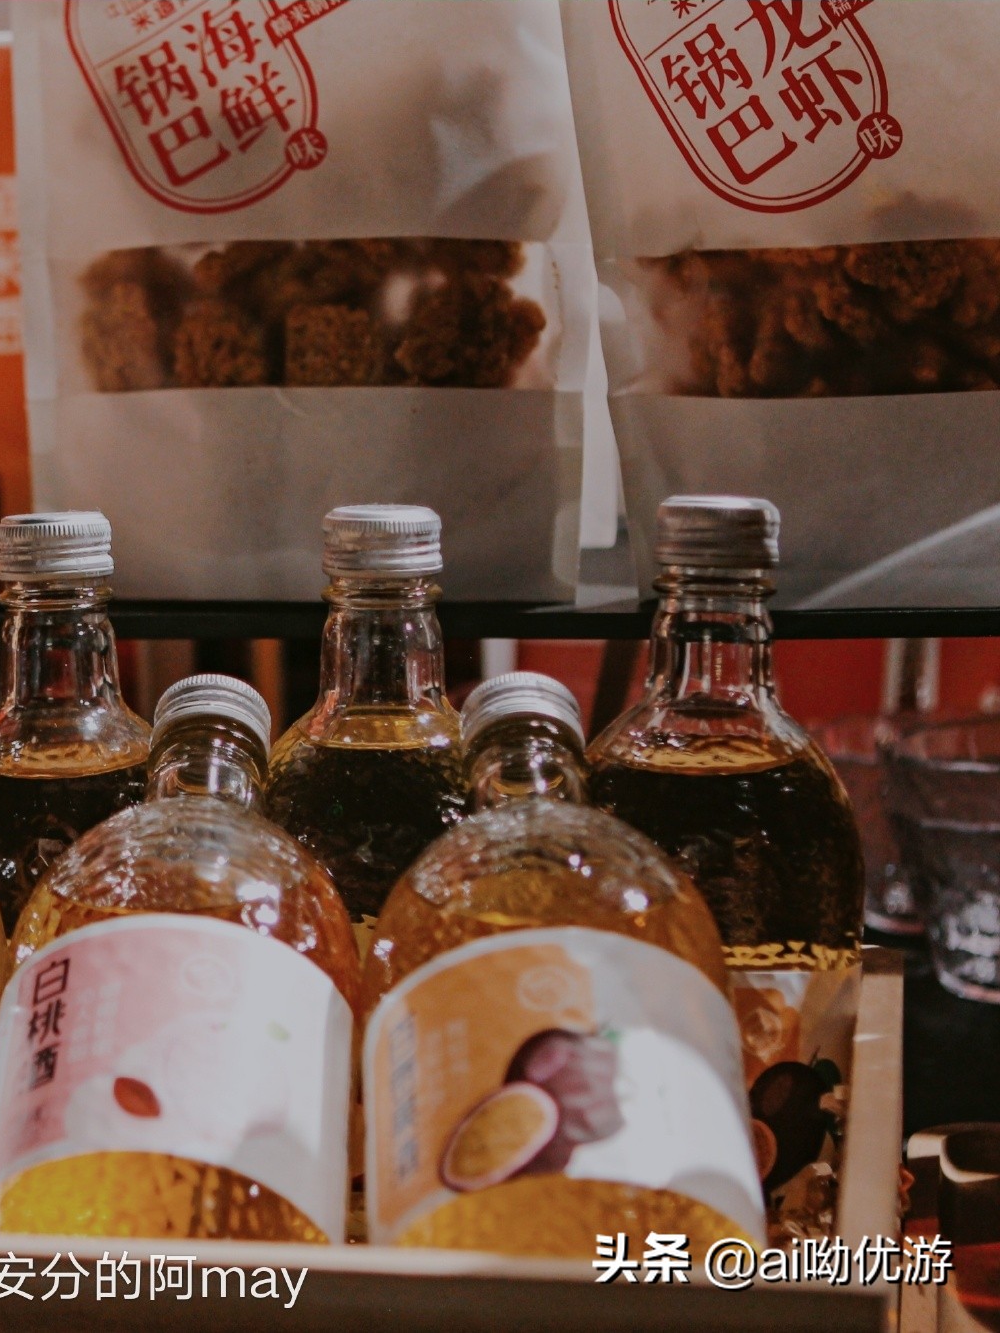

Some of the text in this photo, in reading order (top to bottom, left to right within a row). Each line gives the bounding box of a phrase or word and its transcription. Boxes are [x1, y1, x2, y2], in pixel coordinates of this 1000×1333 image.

[113, 40, 232, 187] 锅巴
[181, 11, 296, 153] 海鲜
[660, 22, 798, 186] 锅巴
[734, 0, 863, 144] 龙虾
[858, 116, 901, 156] 味
[287, 131, 326, 164] 味
[26, 956, 71, 1091] 白桃酒
